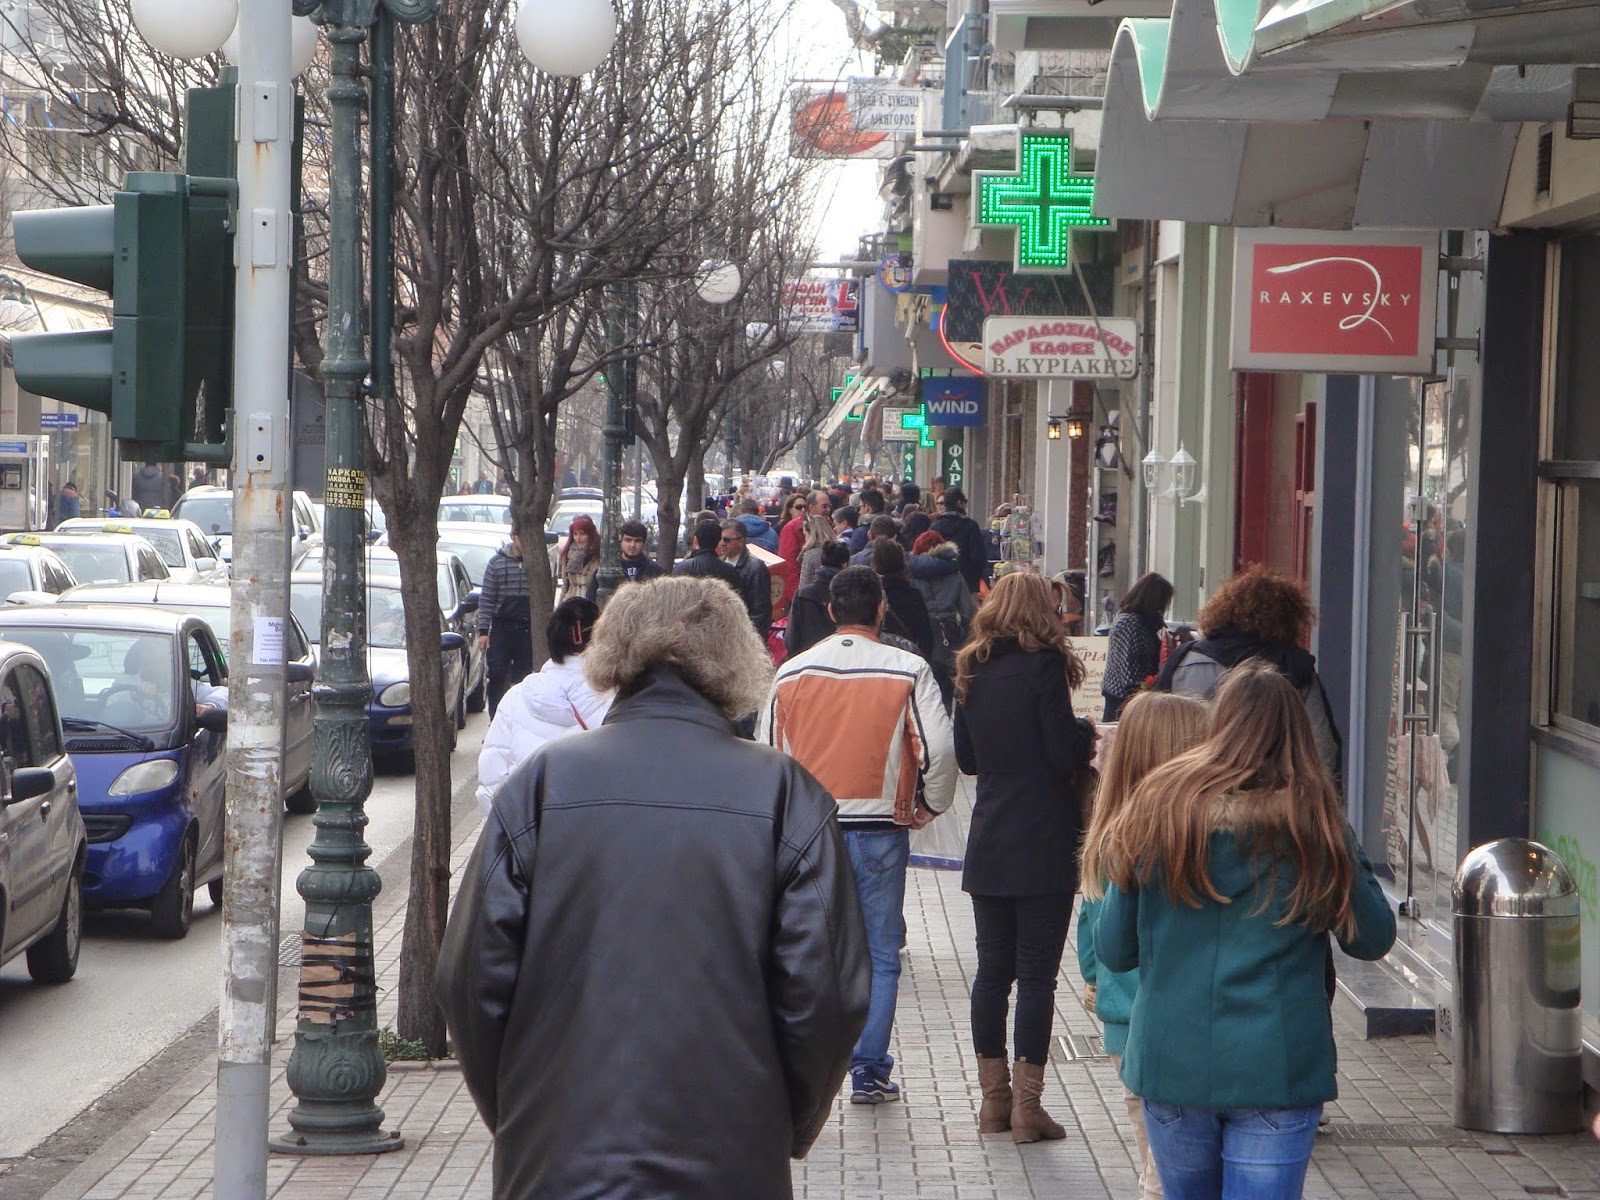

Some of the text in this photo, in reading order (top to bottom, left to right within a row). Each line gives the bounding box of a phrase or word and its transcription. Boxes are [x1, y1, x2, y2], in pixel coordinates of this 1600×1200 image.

[1260, 291, 1411, 306] RAXEVSKY
[989, 321, 1135, 358] ΠΑΡΑΔΟΣΙΑΚΟΣ
[1029, 341, 1096, 356] ΚΑΦΕΣ
[1016, 357, 1134, 375] ΚΥΡΙΑΚΗΣ
[927, 399, 979, 414] WIND
